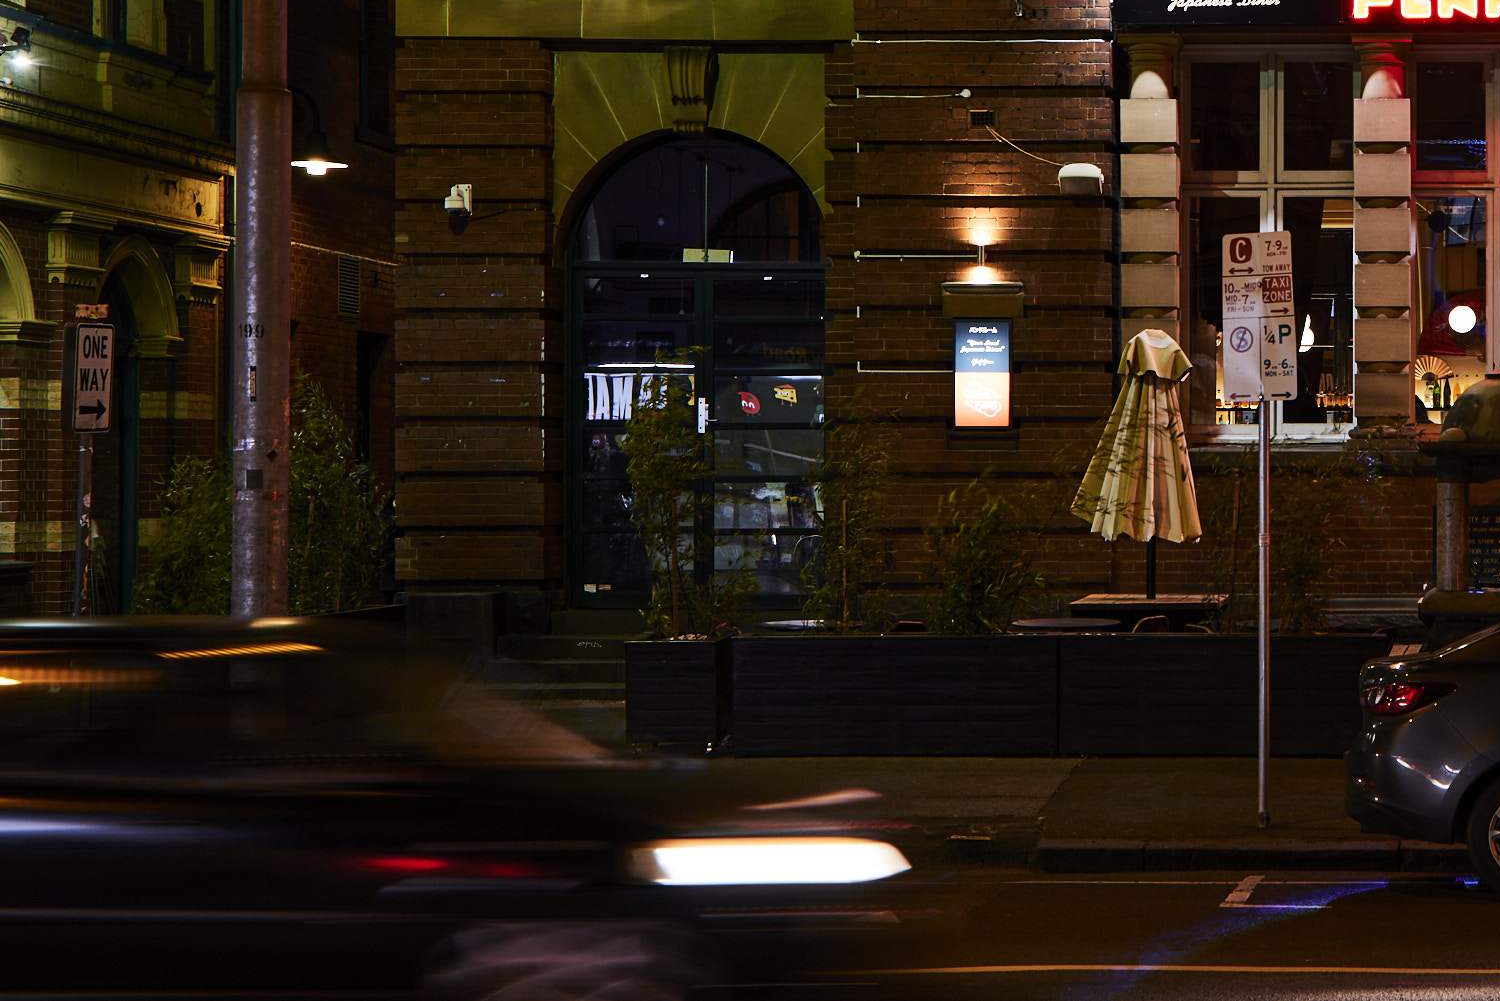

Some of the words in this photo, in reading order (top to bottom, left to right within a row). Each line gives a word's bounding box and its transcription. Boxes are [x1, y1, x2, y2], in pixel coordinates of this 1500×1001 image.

[1263, 265, 1275, 273] TOW
[1275, 264, 1291, 272] AWAY
[1265, 277, 1290, 289] TAXI
[1263, 290, 1292, 302] ZONE
[83, 335, 109, 359] ONE
[80, 368, 110, 391] WAY
